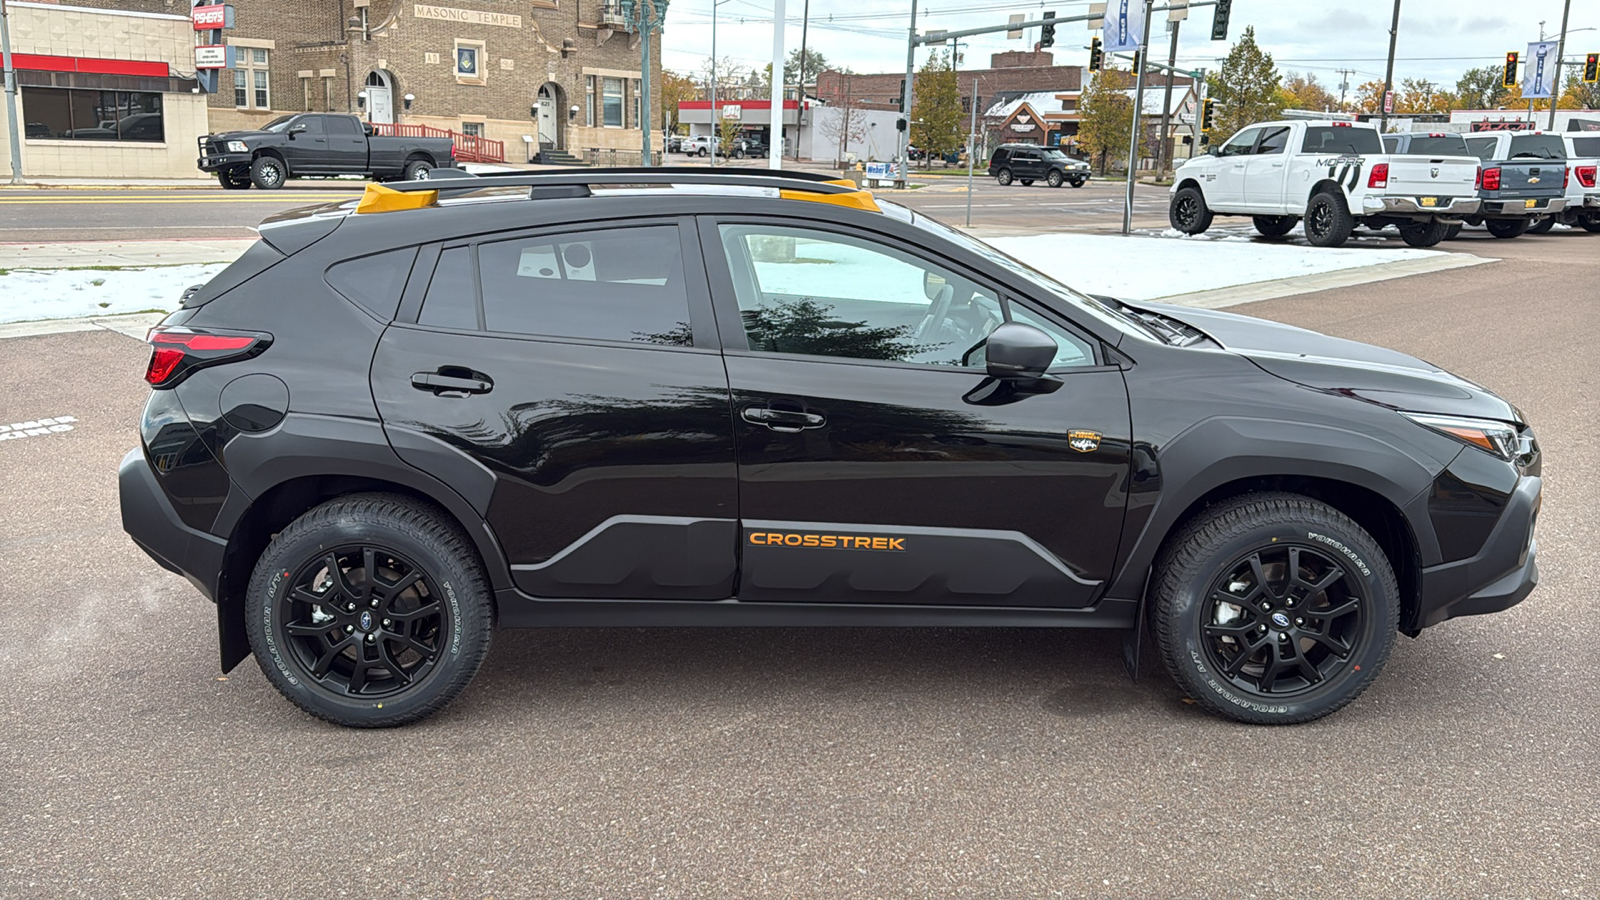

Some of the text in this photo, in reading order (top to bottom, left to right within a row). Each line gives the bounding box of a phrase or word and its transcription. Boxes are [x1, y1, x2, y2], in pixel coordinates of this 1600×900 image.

[416, 6, 520, 26] MASONIC TEMPLE
[1316, 157, 1366, 168] MOPAR
[749, 532, 905, 550] CROSSTREK
[1307, 532, 1371, 577] YOKOHAMA
[263, 606, 299, 685] GEOLANDAR
[1208, 679, 1288, 714] GEOLANDAR
